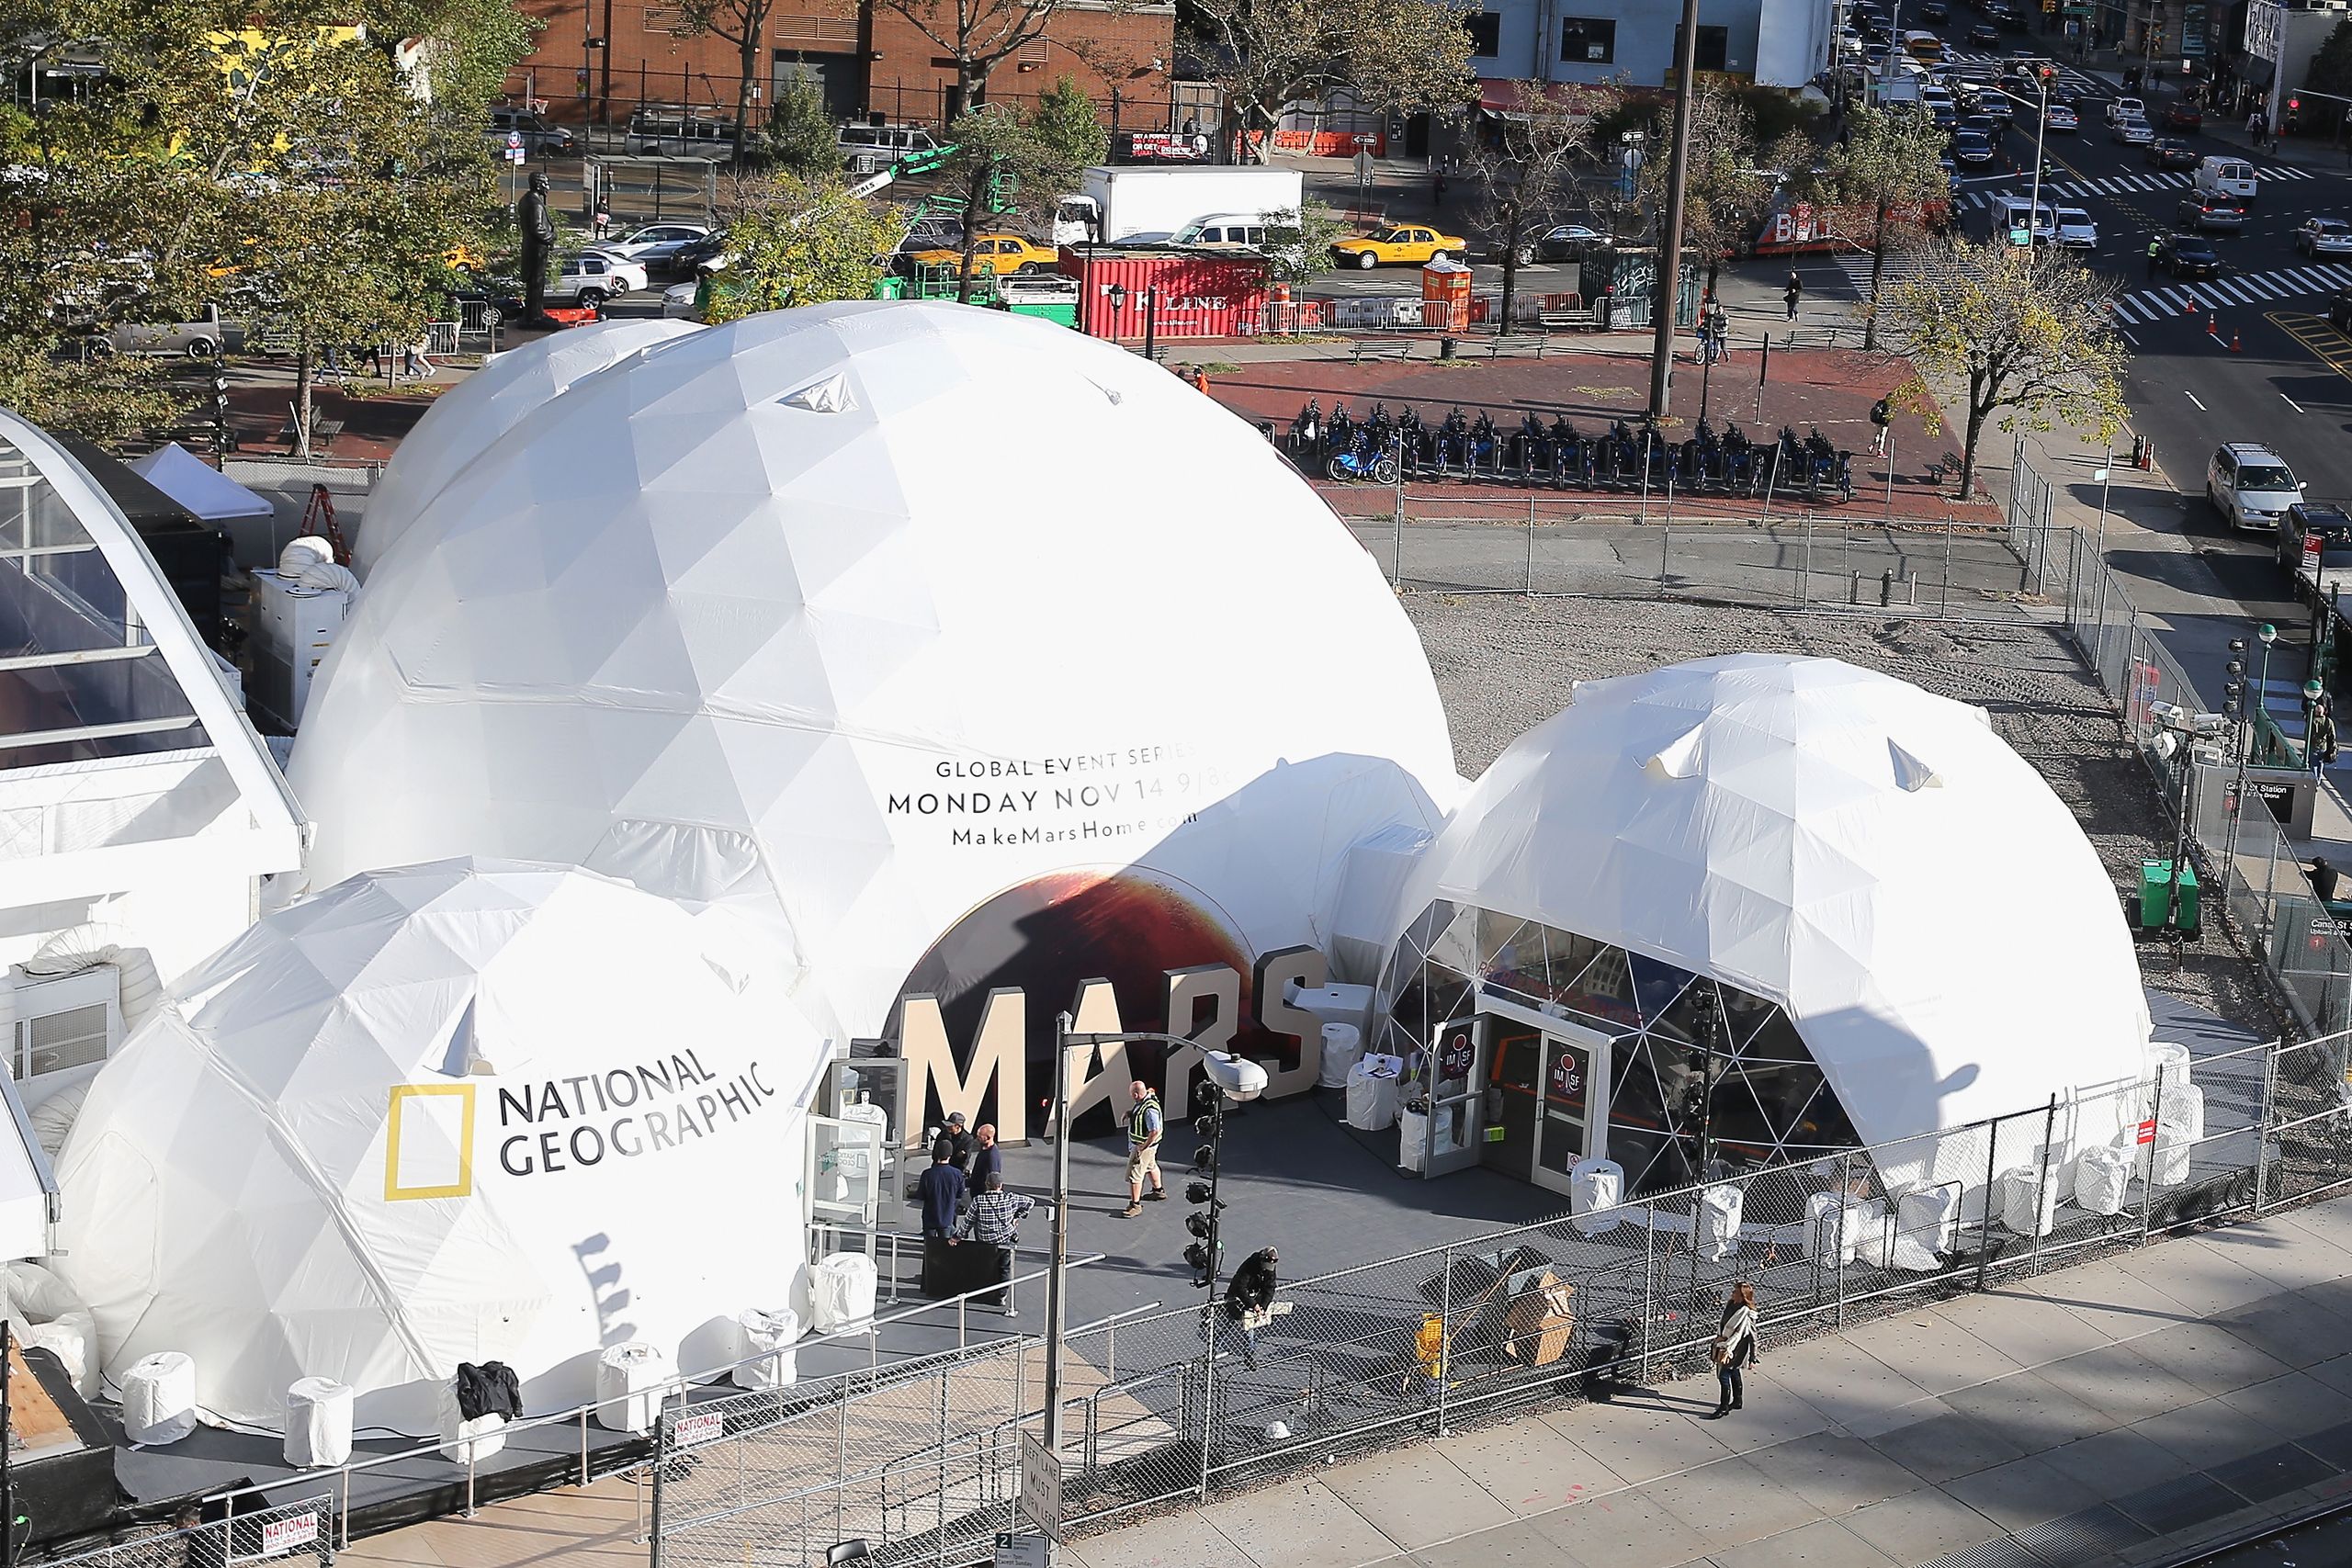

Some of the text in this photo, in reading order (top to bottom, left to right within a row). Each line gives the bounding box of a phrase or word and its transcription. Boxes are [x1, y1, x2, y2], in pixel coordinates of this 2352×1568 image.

[1165, 296, 1227, 311] LINE
[935, 740, 1197, 778] GLOBAL EVENT SERIES
[888, 790, 1038, 815] MONDAY
[1055, 783, 1120, 809] NOV
[1135, 778, 1164, 800] 14
[2225, 782, 2247, 791] Cal
[2260, 784, 2287, 794] Station
[2336, 920, 2347, 930] St
[900, 944, 1328, 1149] MARS
[498, 1048, 717, 1127] NATIONAL
[499, 1061, 775, 1177] GEOGRAPHIC
[676, 1414, 720, 1434] NATIONAL
[1025, 1443, 1057, 1483] LEFT LANE
[1030, 1471, 1050, 1501] MUST
[1023, 1490, 1056, 1529] TURN LEFT
[265, 1514, 316, 1540] NATIONAL
[1000, 1535, 1009, 1548] 2
